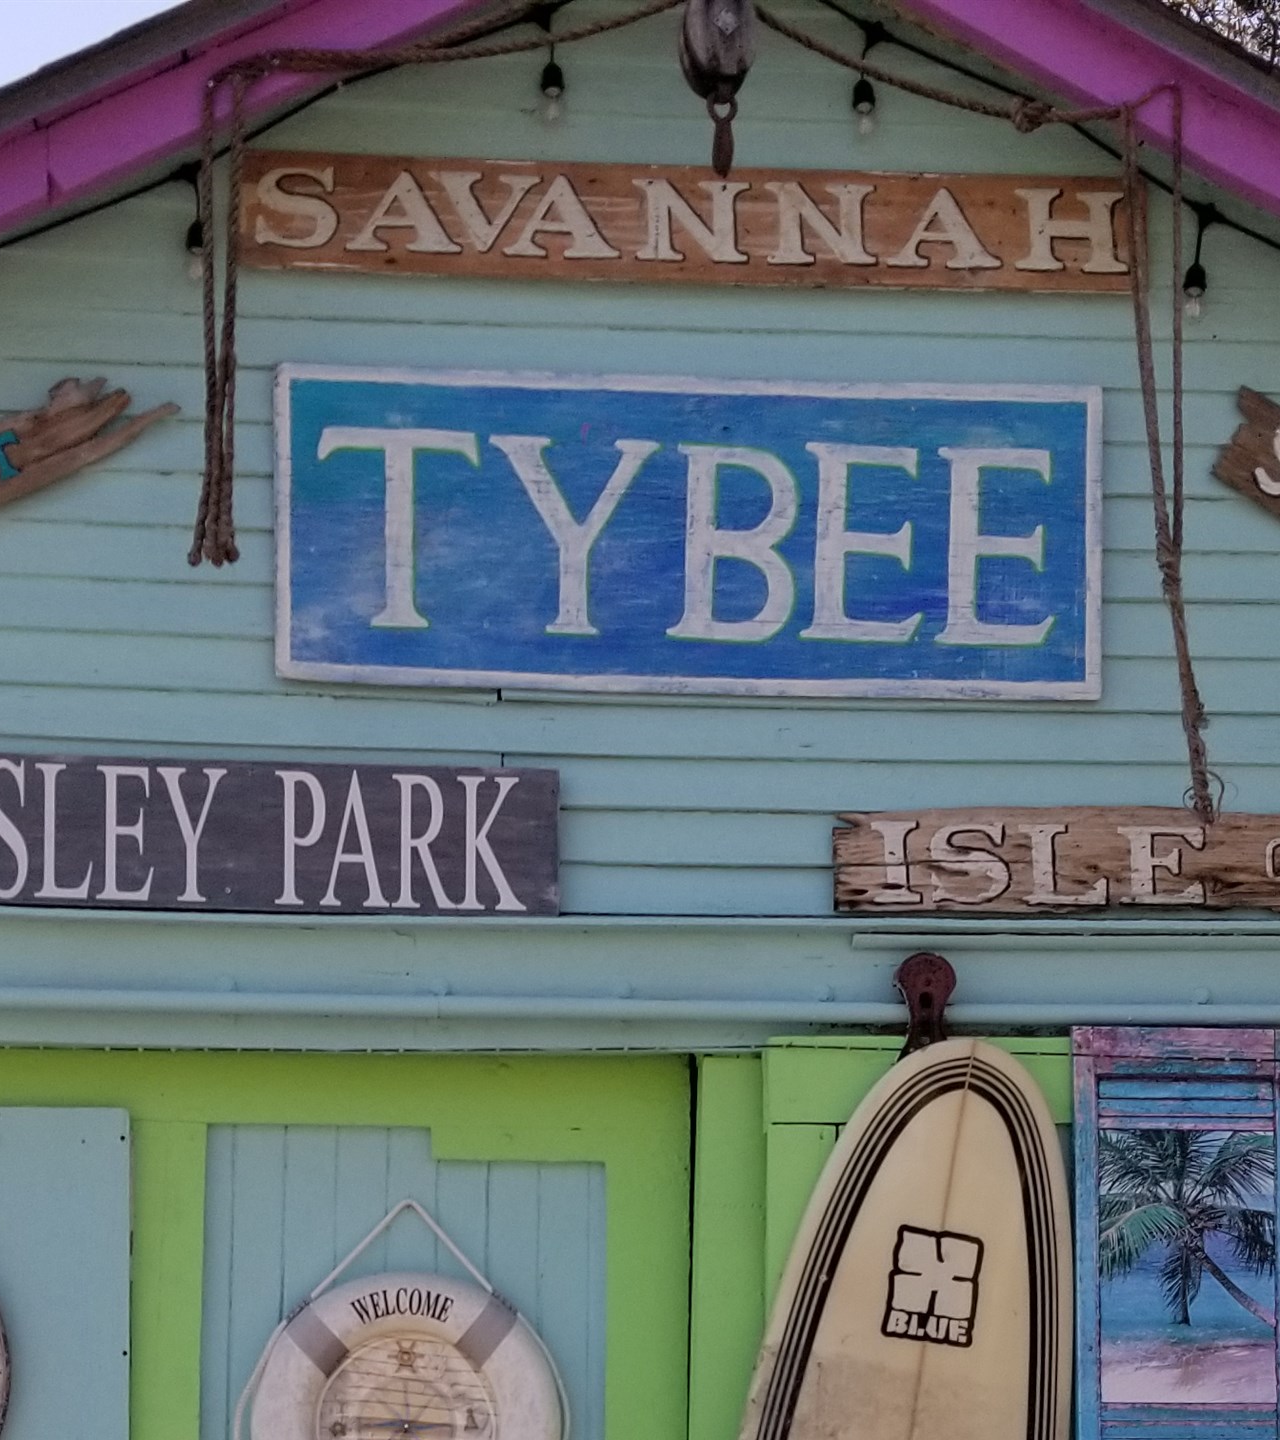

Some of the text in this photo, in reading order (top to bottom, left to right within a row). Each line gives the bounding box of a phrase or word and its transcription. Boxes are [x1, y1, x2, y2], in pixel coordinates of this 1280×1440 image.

[254, 167, 1130, 274] SAVANNAH
[317, 427, 1056, 646] TYBEE
[274, 767, 526, 912] PARK
[869, 818, 1208, 906] ISLE
[350, 1287, 454, 1325] WELCOME
[886, 1310, 969, 1344] BLUE
